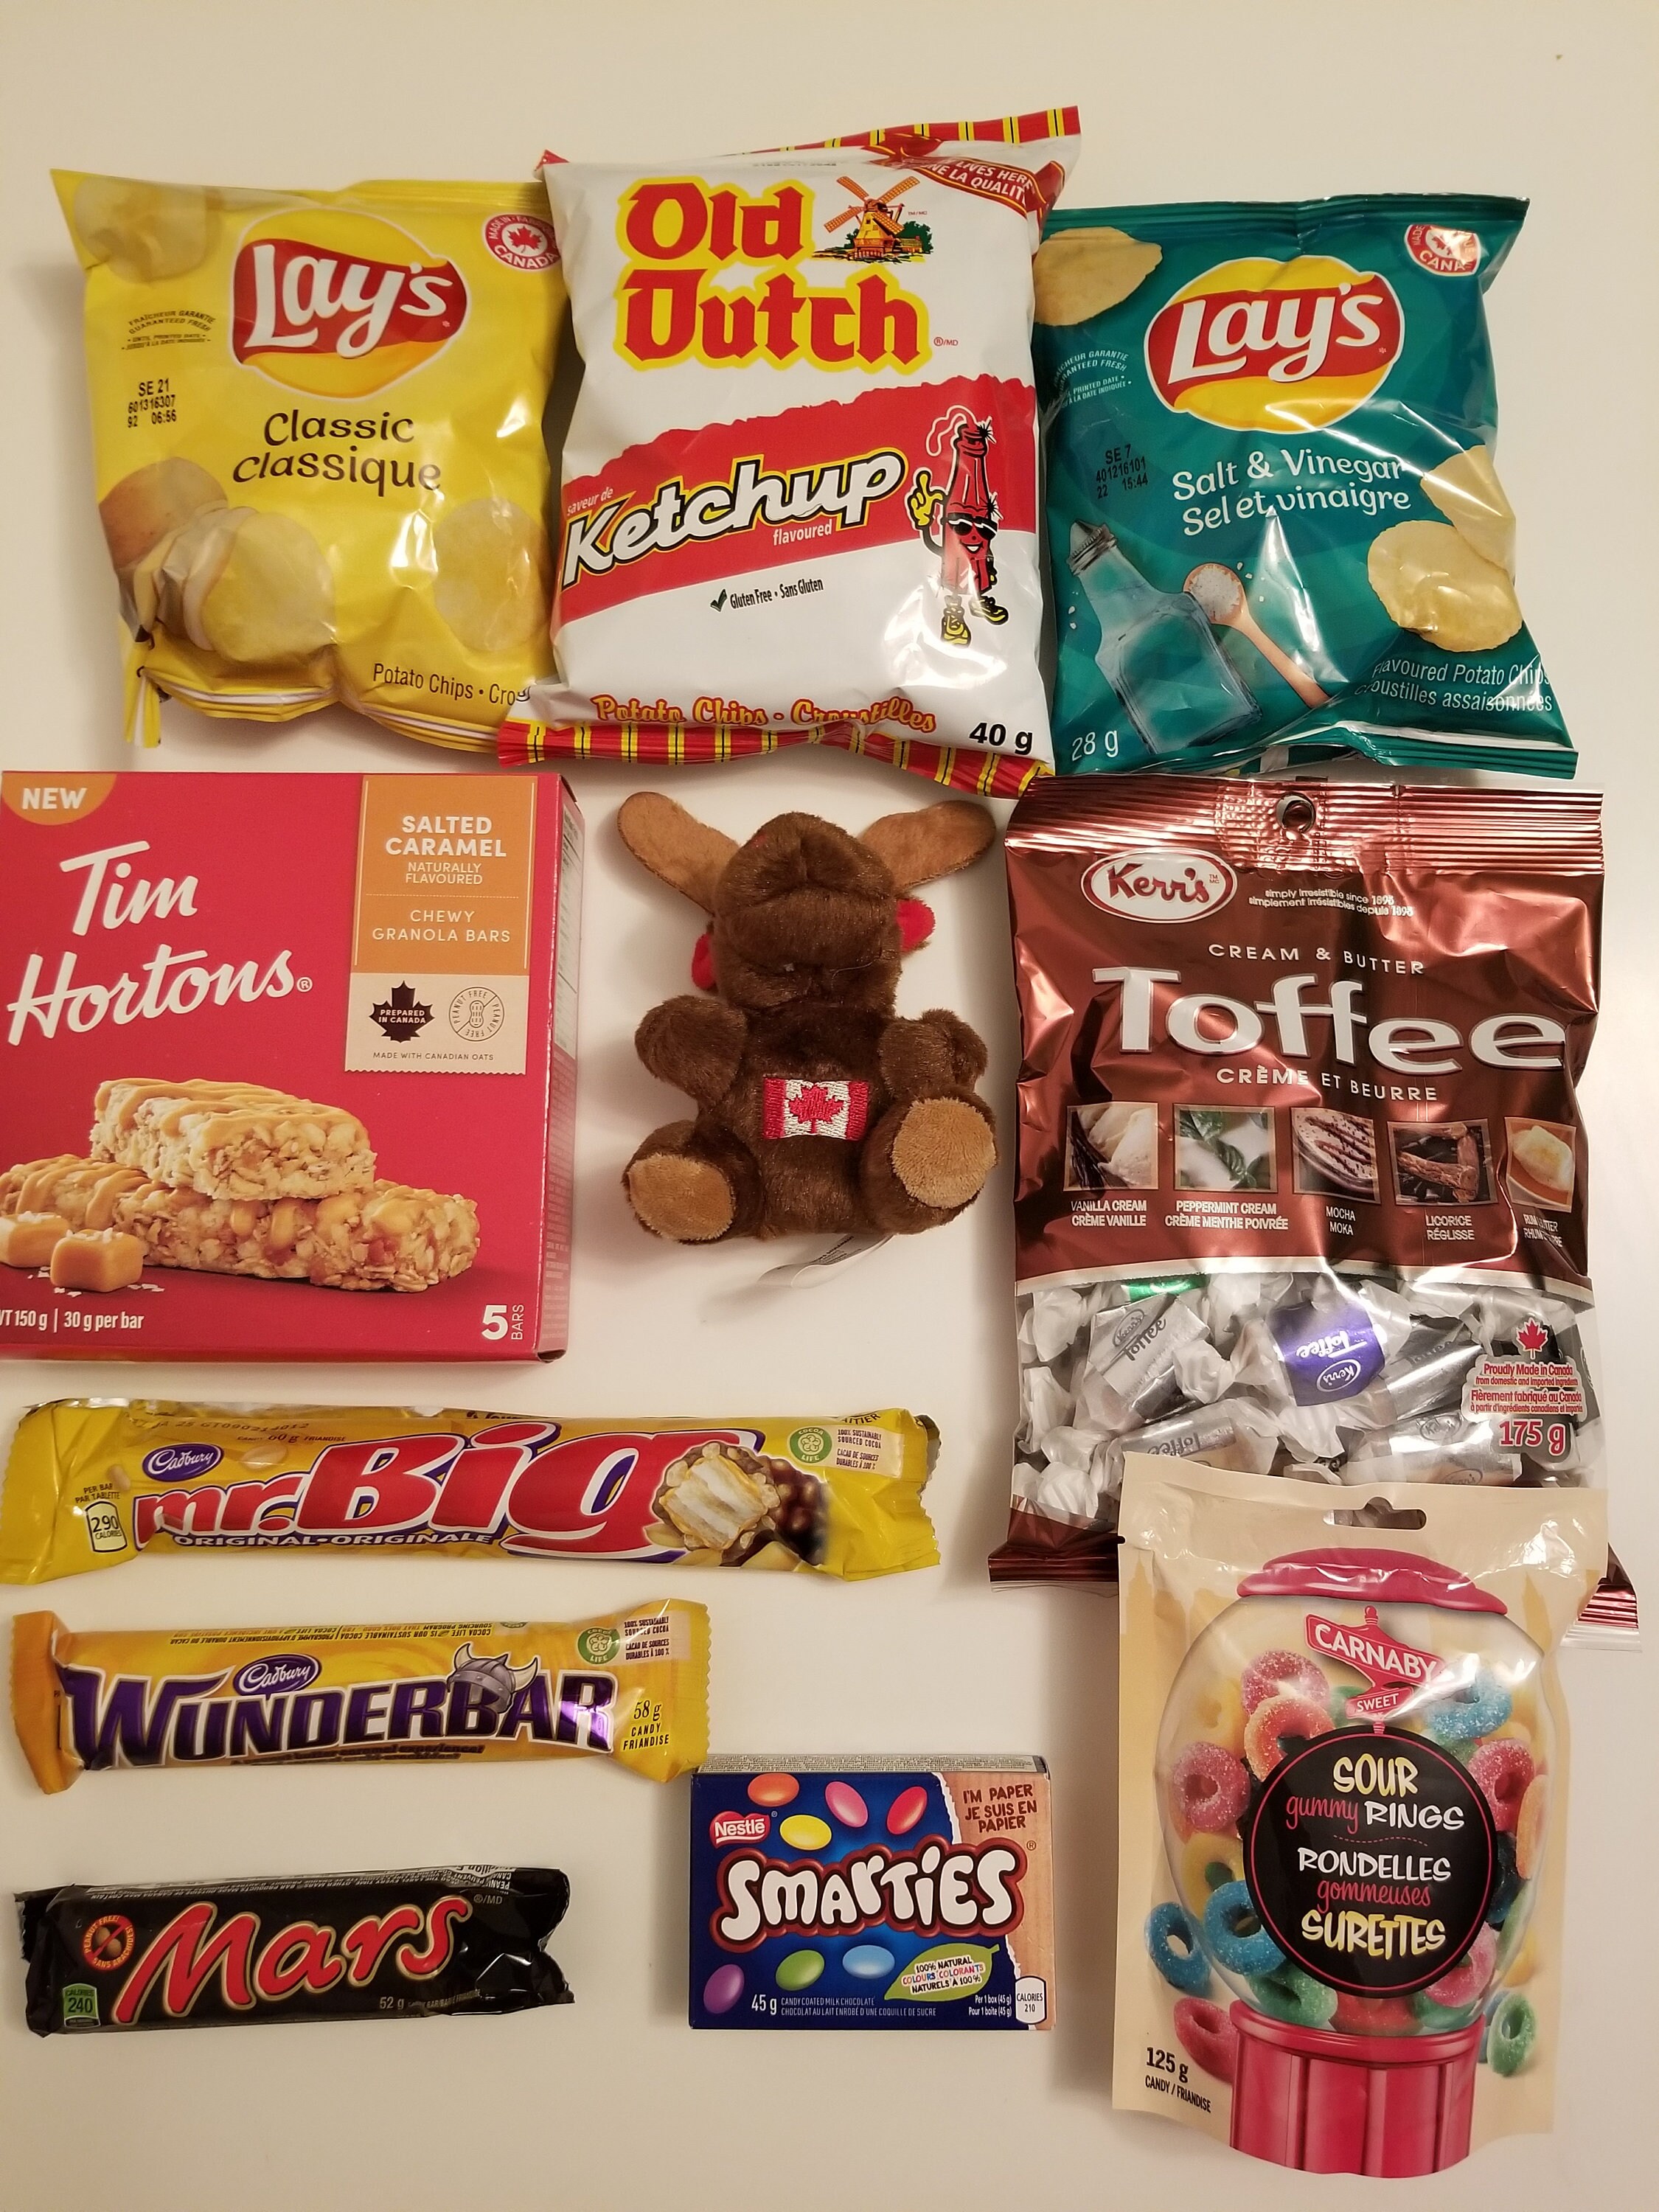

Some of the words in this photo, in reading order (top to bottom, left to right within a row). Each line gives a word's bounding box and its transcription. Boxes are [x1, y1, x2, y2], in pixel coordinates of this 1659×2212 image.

[955, 161, 996, 176] LIVES
[948, 169, 968, 183] LA
[970, 177, 1026, 207] QUALIT
[625, 181, 804, 262] Old
[494, 245, 559, 268] CANADA
[243, 243, 453, 359] Lay's
[128, 318, 186, 334] GUARANTEED
[178, 310, 216, 324] GARANTIE
[622, 268, 922, 366] Dutch
[1167, 283, 1384, 384] Lay's
[1088, 349, 1129, 361] GARANTIE
[1100, 358, 1127, 372] FRESH
[138, 380, 154, 397] SE
[157, 378, 170, 394] 21
[1073, 380, 1101, 394] PRINTED
[151, 409, 177, 424] 06:56
[263, 409, 414, 446] Classic
[1105, 447, 1121, 465] SE
[233, 445, 442, 498] Classique
[1096, 456, 1147, 484] 401216101
[1172, 460, 1239, 501] Salt
[1246, 449, 1271, 479] &
[1279, 448, 1404, 484] Vinegar
[1121, 472, 1149, 491] 15:44
[566, 490, 599, 515] saveur
[600, 486, 614, 501] de
[1181, 504, 1231, 537] Sel
[1236, 493, 1267, 521] et
[1276, 479, 1412, 514] vinaigre
[562, 451, 905, 590] Ketchup
[772, 518, 833, 546] flavoured
[729, 592, 755, 611] Gluten
[756, 588, 773, 605] Free
[779, 581, 797, 599] Sans
[798, 577, 824, 597] Gluten
[372, 663, 424, 689] Potato
[428, 675, 474, 700] Chips
[1372, 658, 1449, 682] Flavoured
[1453, 664, 1505, 686] Potato
[1509, 661, 1551, 686] Chips
[591, 694, 684, 724] Potato
[692, 695, 769, 726] Chips
[969, 722, 1006, 747] 40
[1014, 729, 1034, 756] g
[1071, 731, 1097, 762] 28
[1104, 730, 1119, 758] g
[21, 787, 87, 810] NEW
[401, 815, 493, 835] SALTED
[385, 837, 507, 858] CARAMEL
[408, 861, 482, 874] NATURALLY
[60, 840, 199, 936] Tim
[405, 873, 483, 886] FLAVOURED
[1106, 862, 1211, 905] Kerr's
[1249, 895, 1305, 909] simplement
[1265, 887, 1298, 900] simply
[1346, 891, 1368, 903] since
[410, 909, 476, 923] CHEWY
[372, 928, 459, 942] GRANOLA
[465, 930, 511, 943] BARS
[1208, 943, 1300, 961] CREAM
[1315, 946, 1331, 961] &
[1343, 949, 1426, 975] BUTTER
[7, 943, 296, 1046] Hortons
[380, 1009, 425, 1017] PREPARED
[390, 1016, 427, 1024] CANADA
[1092, 965, 1569, 1077] Toffee
[1216, 1064, 1310, 1086] CRÈME
[1321, 1071, 1342, 1089] ET
[1349, 1078, 1439, 1102] BEURRE
[1071, 1200, 1110, 1212] VANILLA
[1111, 1200, 1147, 1211] CREAM
[1175, 1200, 1239, 1214] PEPPERMINT
[1240, 1202, 1277, 1215] CREAM
[1326, 1205, 1356, 1222] MOCHA
[1071, 1212, 1105, 1227] CRÈME
[1106, 1214, 1147, 1227] VANILLE
[1165, 1212, 1201, 1228] CRÈME
[1202, 1215, 1244, 1229] MENTHE
[1245, 1215, 1289, 1231] POIVRÉE
[1329, 1221, 1354, 1236] MOKA
[1425, 1214, 1472, 1227] LICORICE
[1427, 1227, 1475, 1241] RÉGLISSE
[15, 1310, 37, 1326] 150
[39, 1312, 48, 1331] g
[63, 1311, 81, 1328] 30
[83, 1314, 92, 1332] g
[95, 1315, 119, 1332] per
[121, 1311, 145, 1329] bar
[481, 1304, 509, 1341] 5
[511, 1303, 525, 1341] BARS
[1295, 1329, 1364, 1359] Toffee
[1484, 1363, 1515, 1377] Proudly
[1516, 1363, 1540, 1376] Made
[1548, 1364, 1573, 1376] Canada
[1490, 1376, 1517, 1385] domestic
[1471, 1388, 1514, 1402] Fièrement
[1514, 1390, 1547, 1405] fabriqué
[1498, 1420, 1543, 1446] 175
[1548, 1425, 1565, 1455] g
[147, 1448, 215, 1475] Cadbury
[91, 1514, 119, 1533] 290
[590, 1654, 609, 1663] LIFE
[1314, 1623, 1438, 1688] CARNABY
[238, 1661, 311, 1693] Cadbury
[633, 1700, 651, 1720] 58
[653, 1703, 662, 1722] g
[1356, 1692, 1399, 1714] SWEET
[56, 1664, 617, 1770] WUNDERBAR
[631, 1722, 661, 1737] CANDY
[623, 1733, 669, 1751] FRIANDISE
[1332, 1753, 1419, 1798] SOUR
[962, 1788, 982, 1804] I'M
[989, 1783, 1034, 1801] PAPER
[964, 1804, 980, 1820] JE
[984, 1802, 1015, 1818] SUIS
[1018, 1799, 1038, 1815] EN
[1286, 1793, 1359, 1834] gummy
[1364, 1800, 1465, 1832] RINGS
[714, 1818, 765, 1837] Nestlé
[978, 1815, 1026, 1834] PAPIER
[1296, 1846, 1452, 1882] RONDELLES
[1316, 1878, 1431, 1914] gommeuses
[83, 1922, 100, 1953] PEANUT
[99, 1915, 119, 1925] FREE!
[1300, 1908, 1447, 1961] SURETTES
[93, 1957, 111, 1968] SANS
[113, 1895, 472, 2025] Mars
[916, 1962, 936, 1973] 100%
[937, 1955, 973, 1969] NATURAL
[902, 1972, 936, 1985] COLOURS
[939, 1964, 984, 1979] COLORANTS
[911, 1980, 950, 1994] NATURELS
[1016, 1992, 1043, 2002] CALORIES
[68, 1997, 93, 2014] 240
[379, 1996, 394, 2009] 52
[397, 1998, 405, 2010] g
[751, 1994, 766, 2011] 45
[769, 1997, 777, 2016] g
[781, 1997, 801, 2006] CANDY
[801, 1997, 824, 2006] COATED
[825, 1997, 840, 2006] MILK
[841, 1997, 874, 2006] CHOCOLATE
[781, 2007, 812, 2017] CHOCOLAT
[878, 2008, 907, 2017] COQUILLE
[1024, 2003, 1036, 2013] 210
[1146, 2047, 1176, 2073] 125
[1178, 2062, 1189, 2084] g
[1145, 2074, 1171, 2095] CANDY
[1176, 2085, 1211, 2114] FRIANDISE
